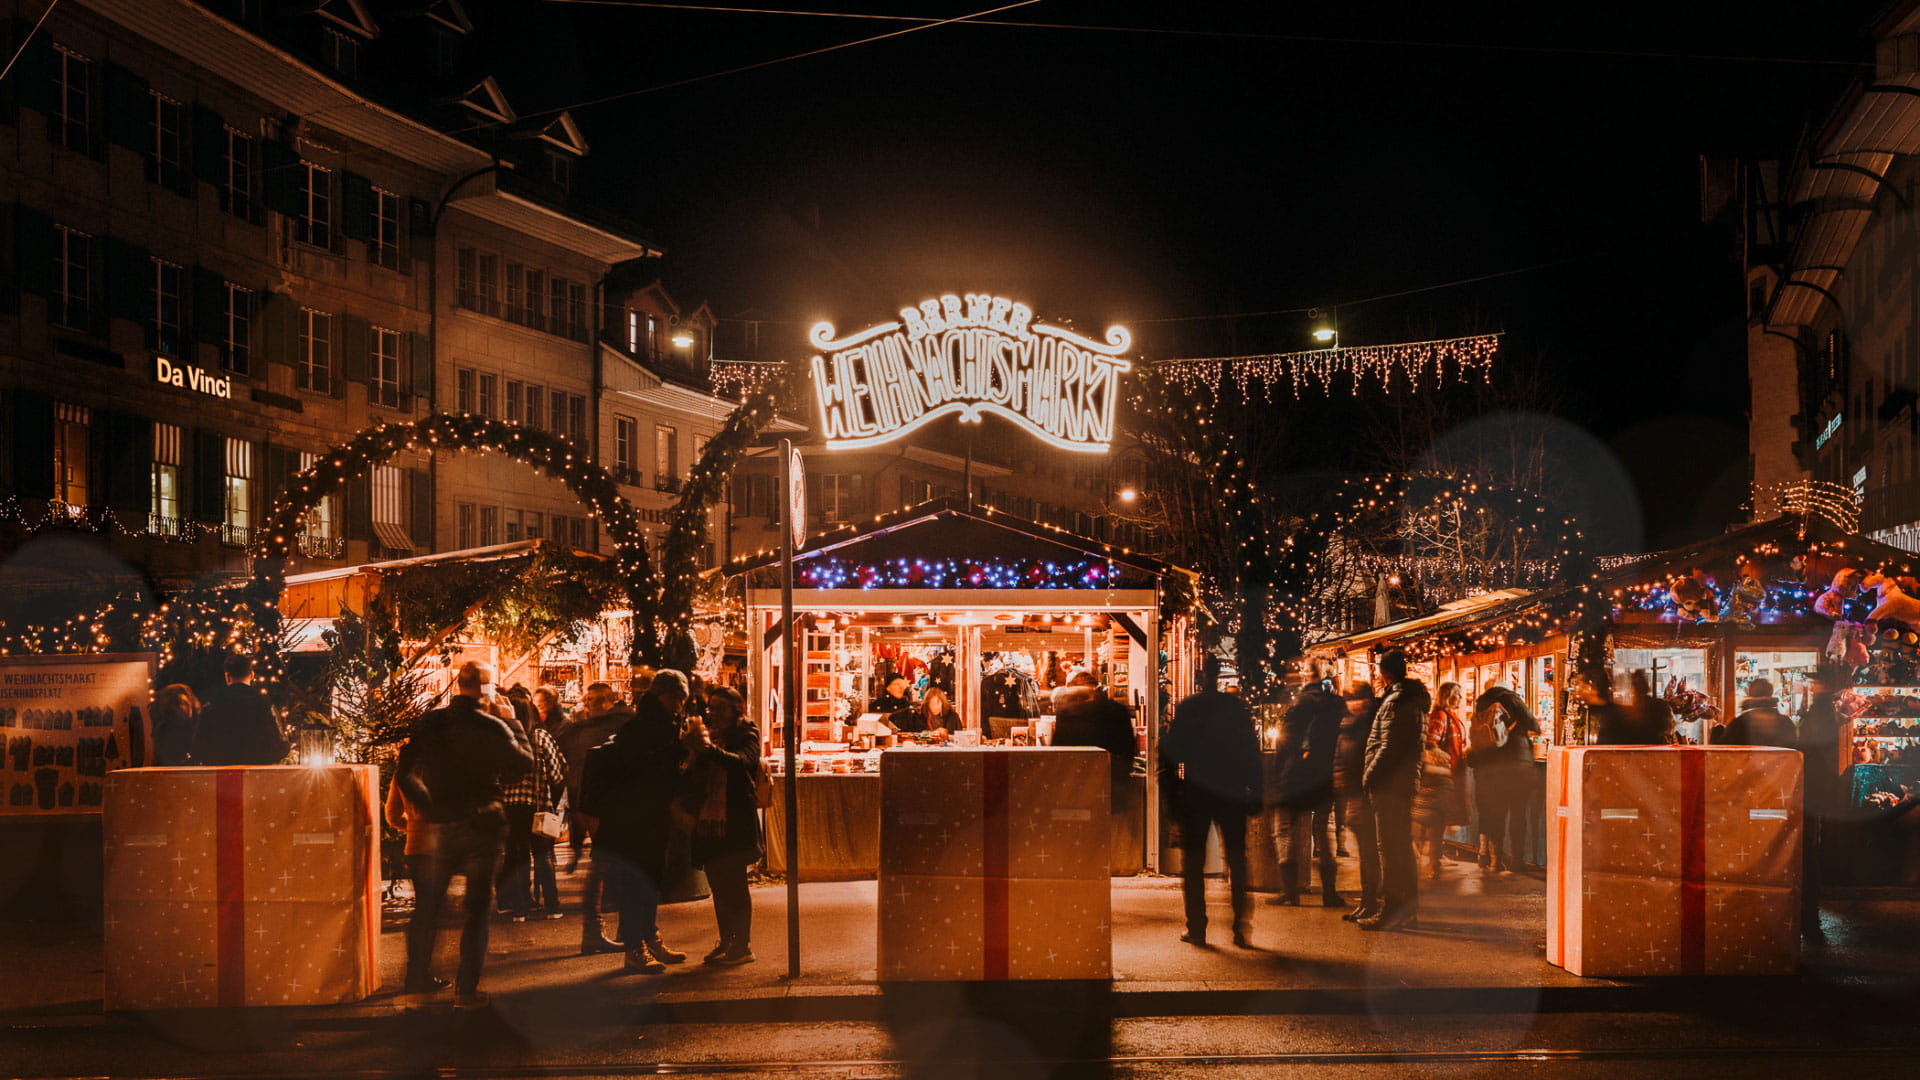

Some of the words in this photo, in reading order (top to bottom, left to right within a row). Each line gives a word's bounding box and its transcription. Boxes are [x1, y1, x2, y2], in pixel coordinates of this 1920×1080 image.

[900, 294, 1032, 341] BERNER
[157, 357, 184, 387] Da
[187, 365, 231, 399] Vinci
[811, 329, 1131, 442] WEIHNACHTSMARKT
[4, 672, 97, 685] WEIHNACHTSMARKT
